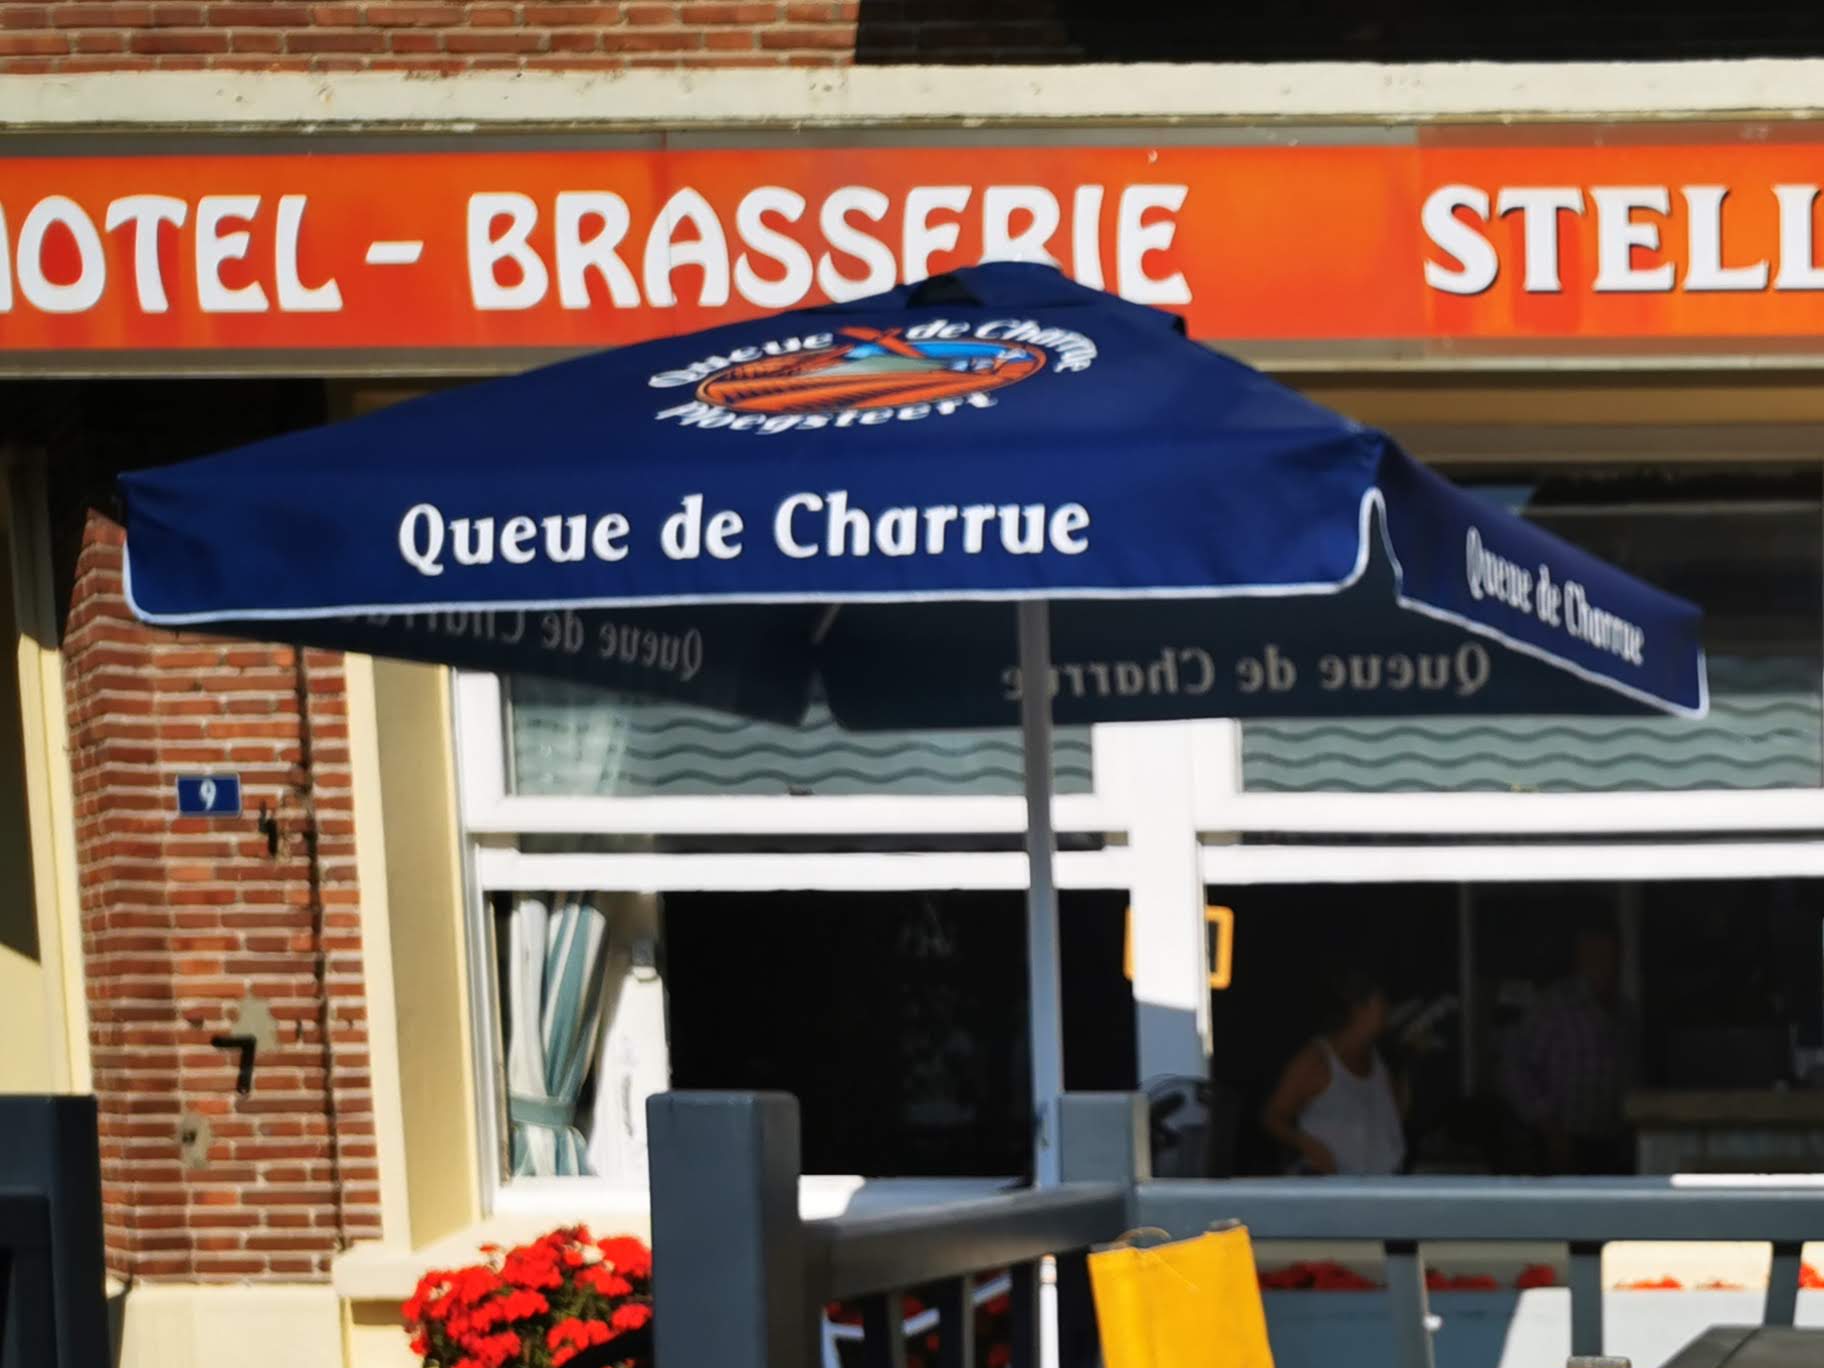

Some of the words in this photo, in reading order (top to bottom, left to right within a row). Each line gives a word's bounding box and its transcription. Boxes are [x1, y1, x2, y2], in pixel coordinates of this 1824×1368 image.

[0, 194, 343, 313] OTEL
[905, 319, 971, 340] de
[398, 503, 631, 576] Queue
[660, 494, 744, 560] de
[773, 491, 1091, 558] Charrue
[1466, 525, 1534, 614] Queue
[1536, 563, 1562, 627] de
[1564, 579, 1645, 666] Charrue
[199, 778, 217, 811] 9
